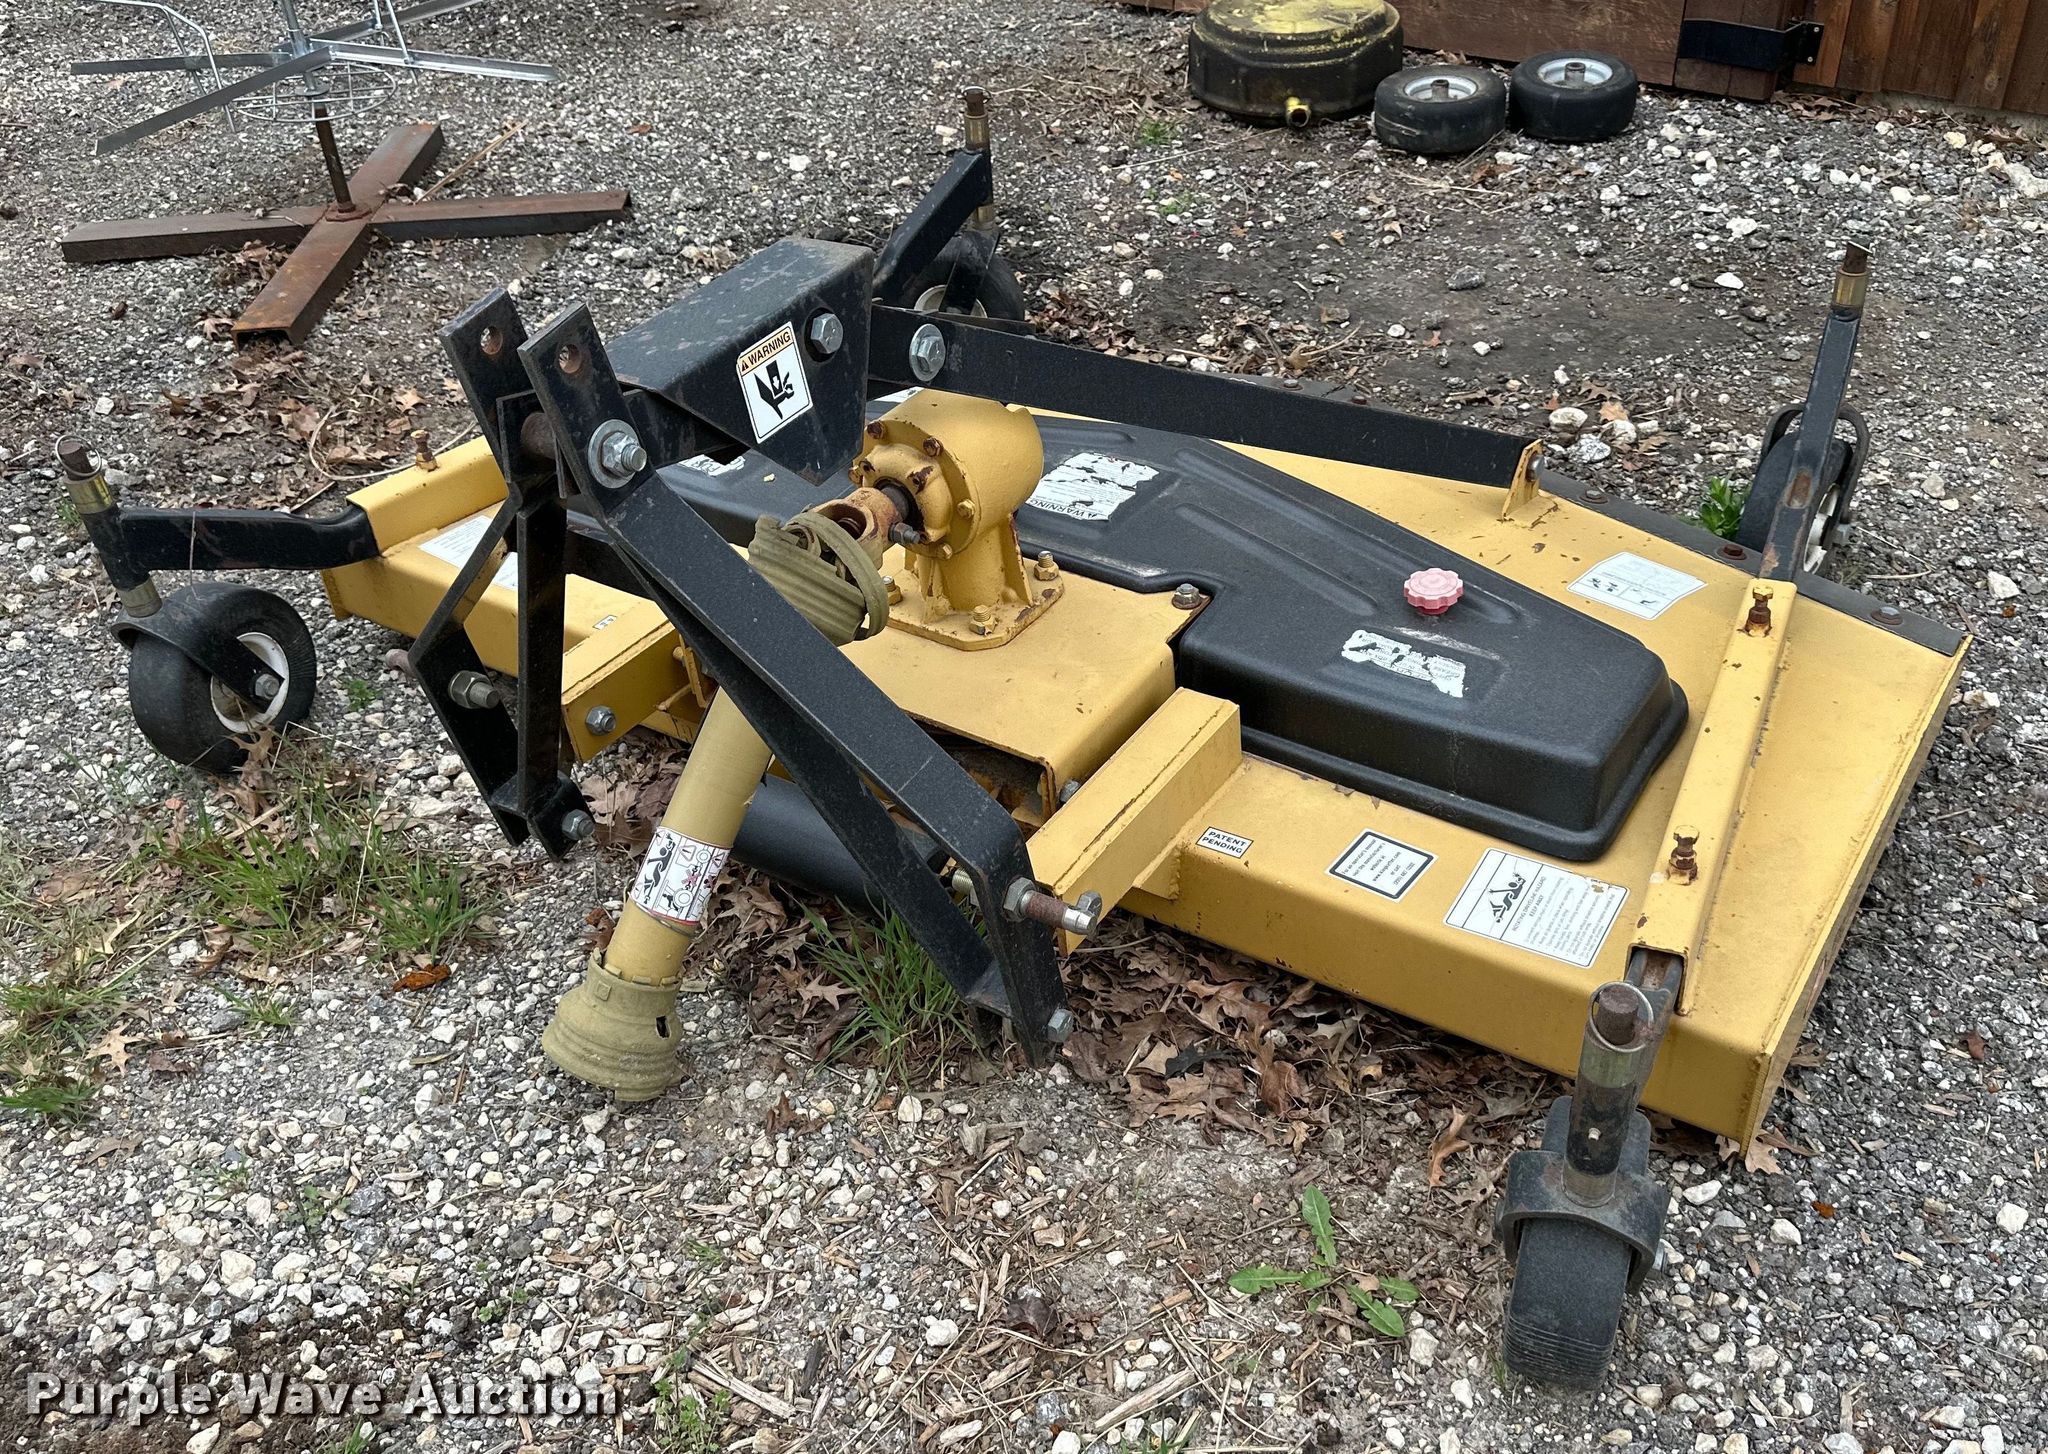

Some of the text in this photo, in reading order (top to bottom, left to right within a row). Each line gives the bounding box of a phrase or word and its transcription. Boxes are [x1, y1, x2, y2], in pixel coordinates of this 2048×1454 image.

[747, 331, 791, 366] WARNING
[1030, 499, 1085, 517] WARNING
[1201, 836, 1243, 853] PENDING
[1208, 831, 1247, 847] PATENT
